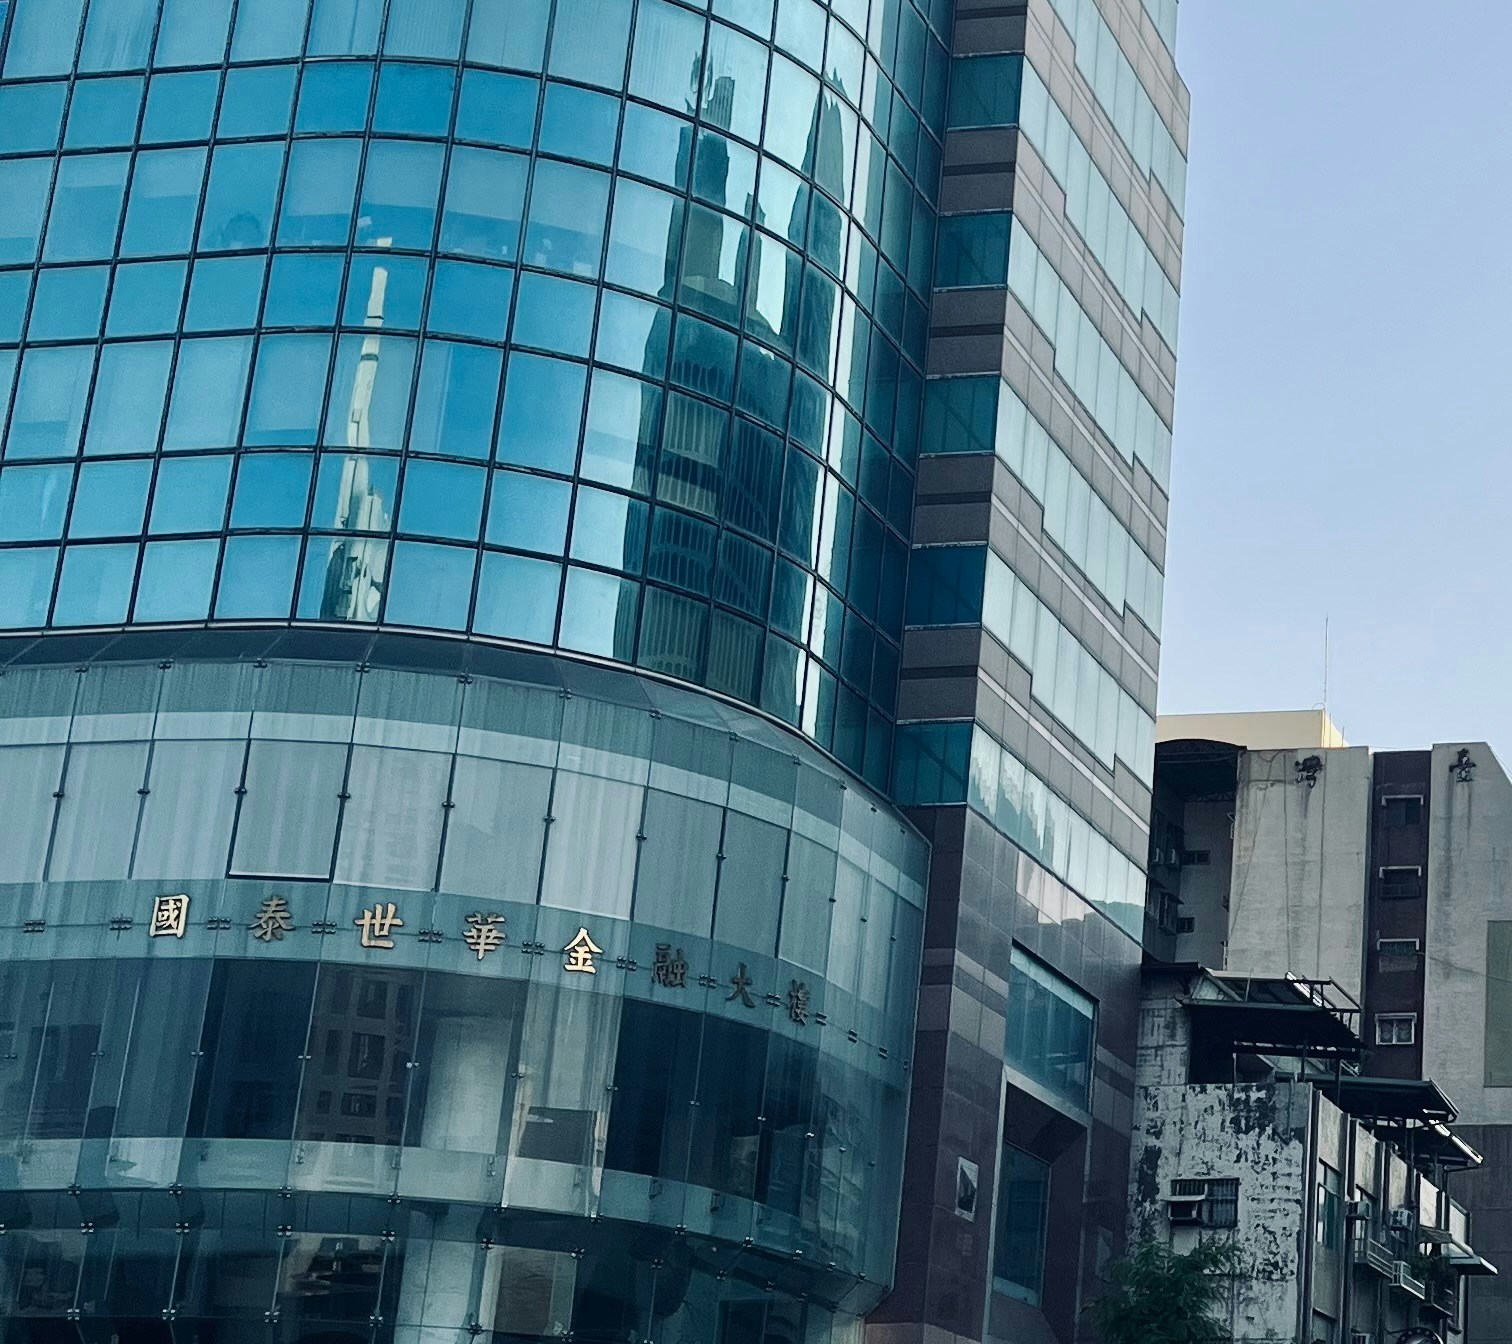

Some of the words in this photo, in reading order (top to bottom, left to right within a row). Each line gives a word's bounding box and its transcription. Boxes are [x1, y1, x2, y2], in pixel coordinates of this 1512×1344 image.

[149, 893, 811, 1027] 國泰世華金融大樓
